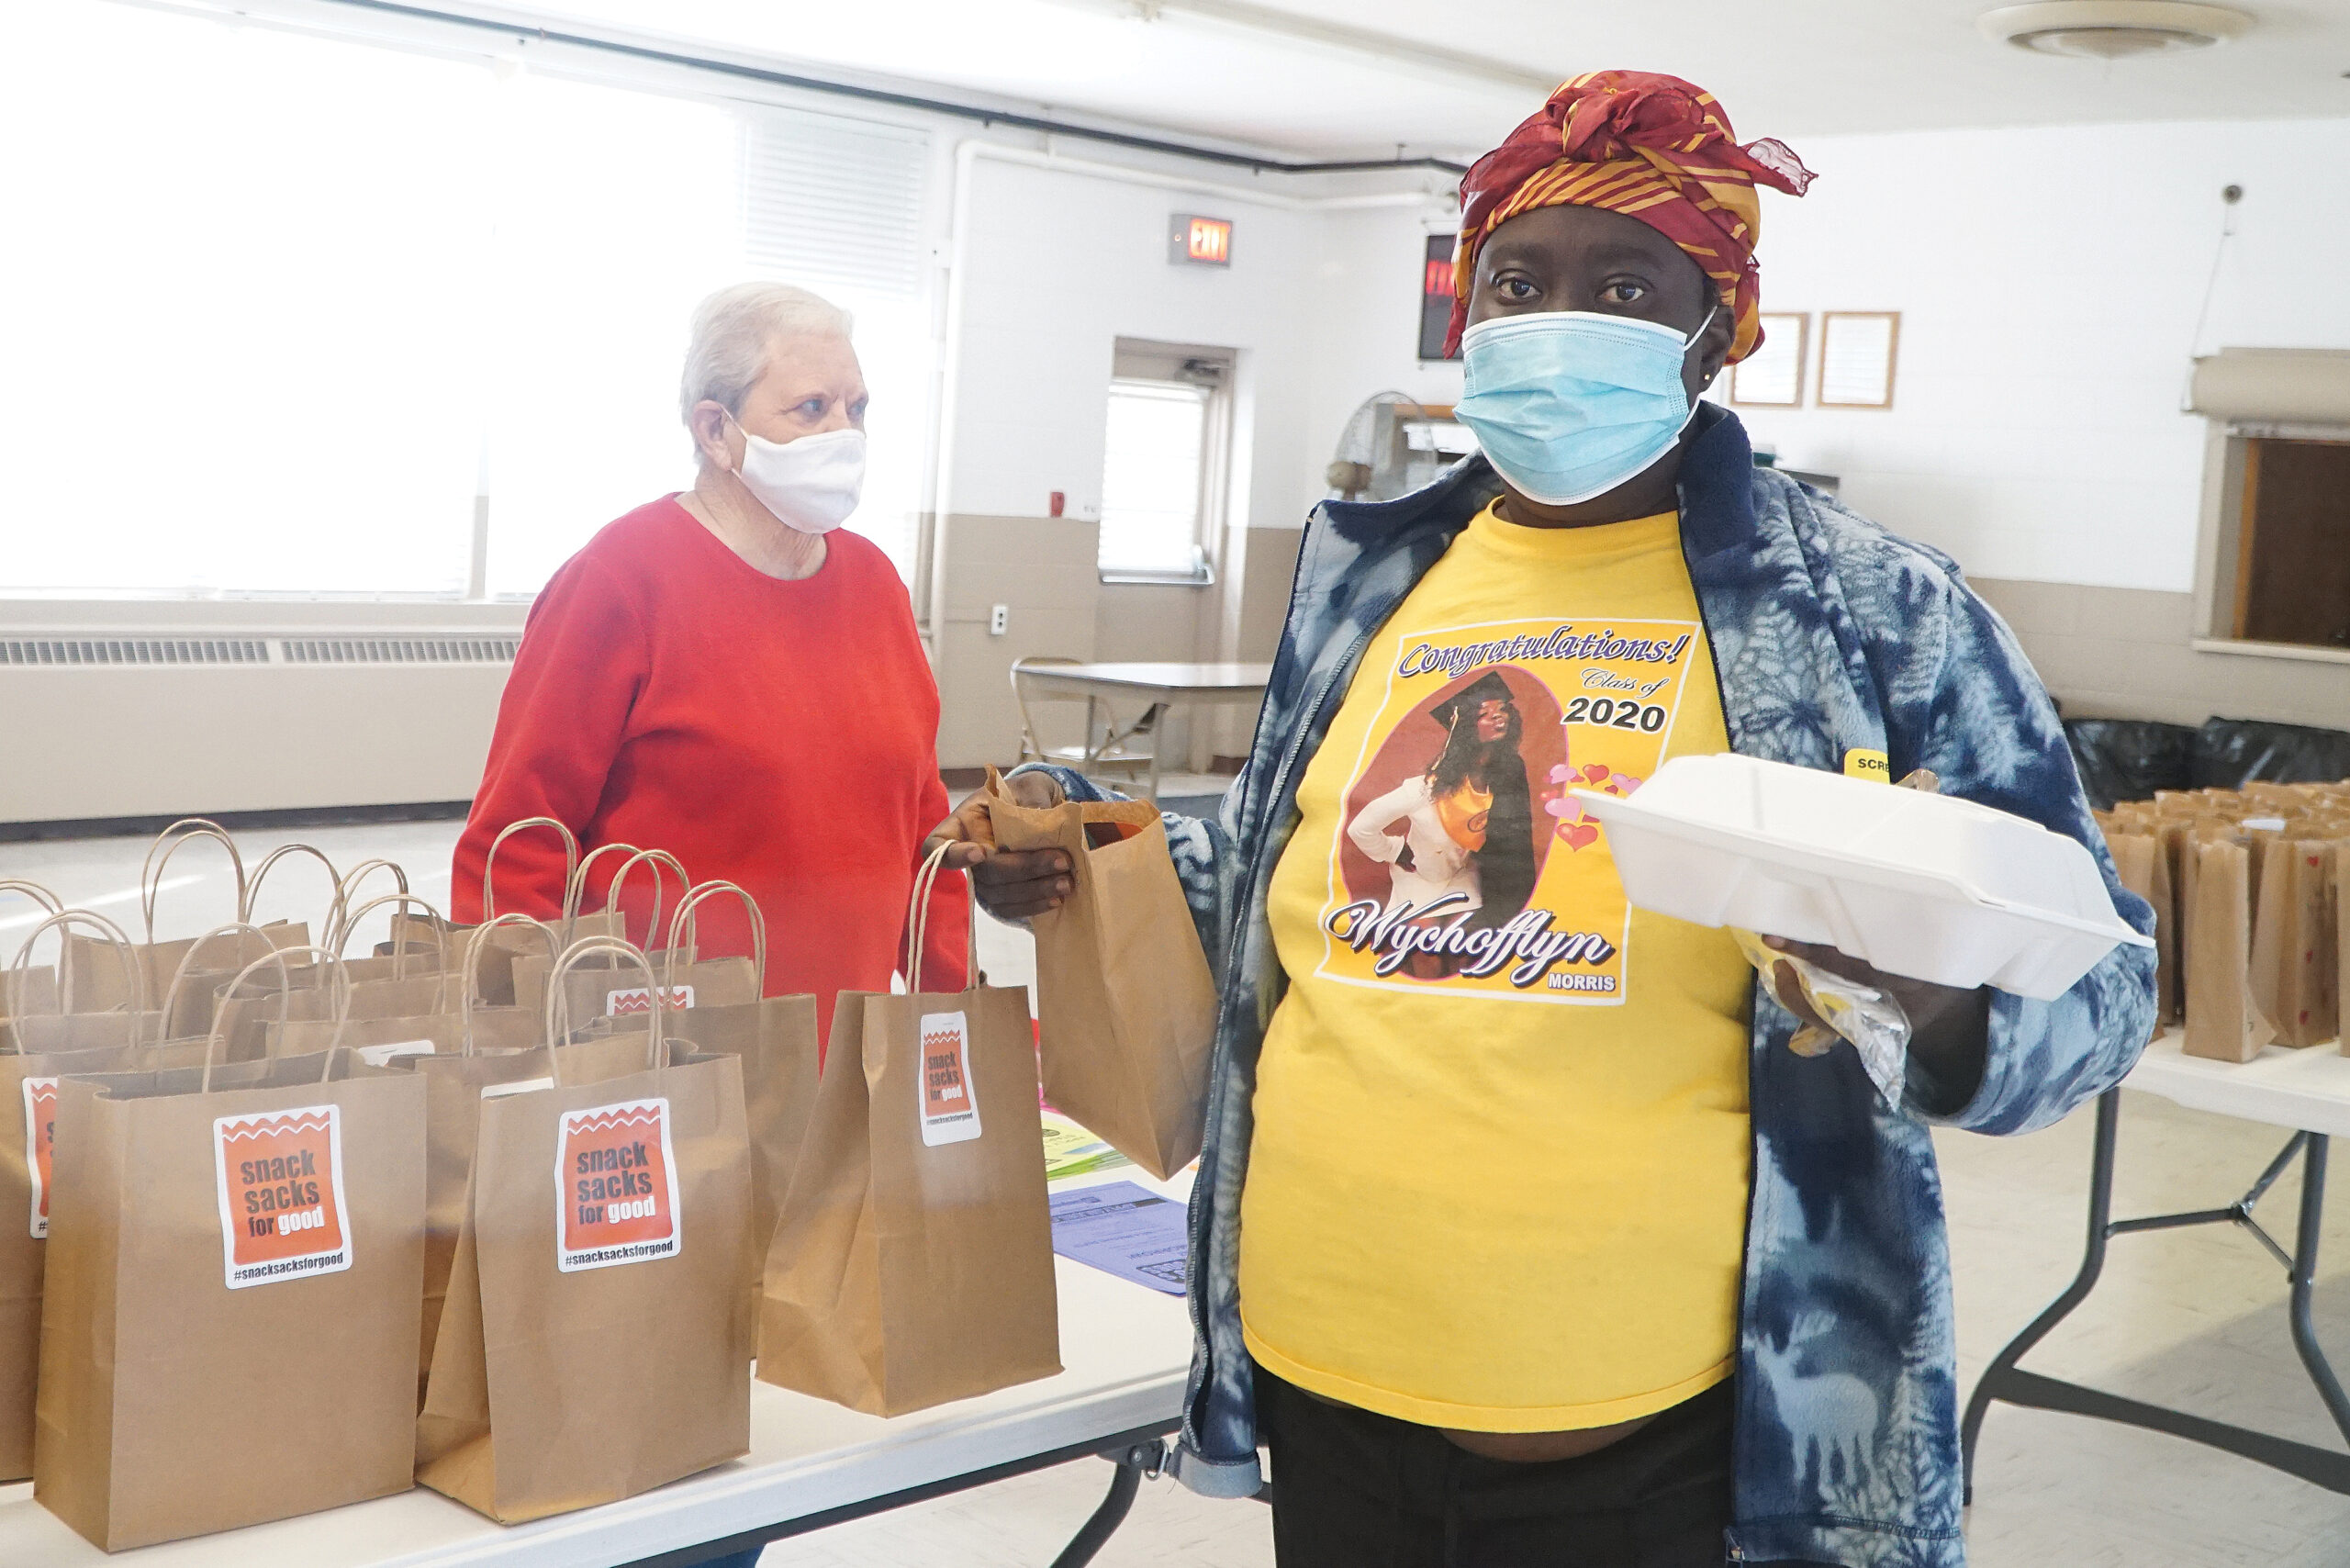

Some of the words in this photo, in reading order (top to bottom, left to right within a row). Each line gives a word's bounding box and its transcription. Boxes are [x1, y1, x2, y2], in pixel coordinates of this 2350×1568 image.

[1397, 625, 1689, 678] Congratulations!
[1581, 667, 1638, 689] Class
[1636, 678, 1670, 699] of
[1561, 696, 1666, 734] 2020
[1324, 891, 1616, 989] Wychofflyn
[1548, 973, 1616, 992] MORRIS
[928, 1051, 956, 1070] snack
[929, 1069, 959, 1087] sacks
[930, 1090, 941, 1101] for
[943, 1085, 962, 1102] good
[240, 1148, 316, 1186] snack
[576, 1141, 649, 1174] snack
[243, 1180, 319, 1215] sacks
[576, 1170, 653, 1203] sacks
[248, 1216, 274, 1238] for
[277, 1205, 325, 1237] good
[578, 1204, 604, 1226] for
[607, 1196, 655, 1225] good
[233, 1252, 343, 1281] #snacksacksforgood
[565, 1239, 673, 1267] #snacksacksforgood
